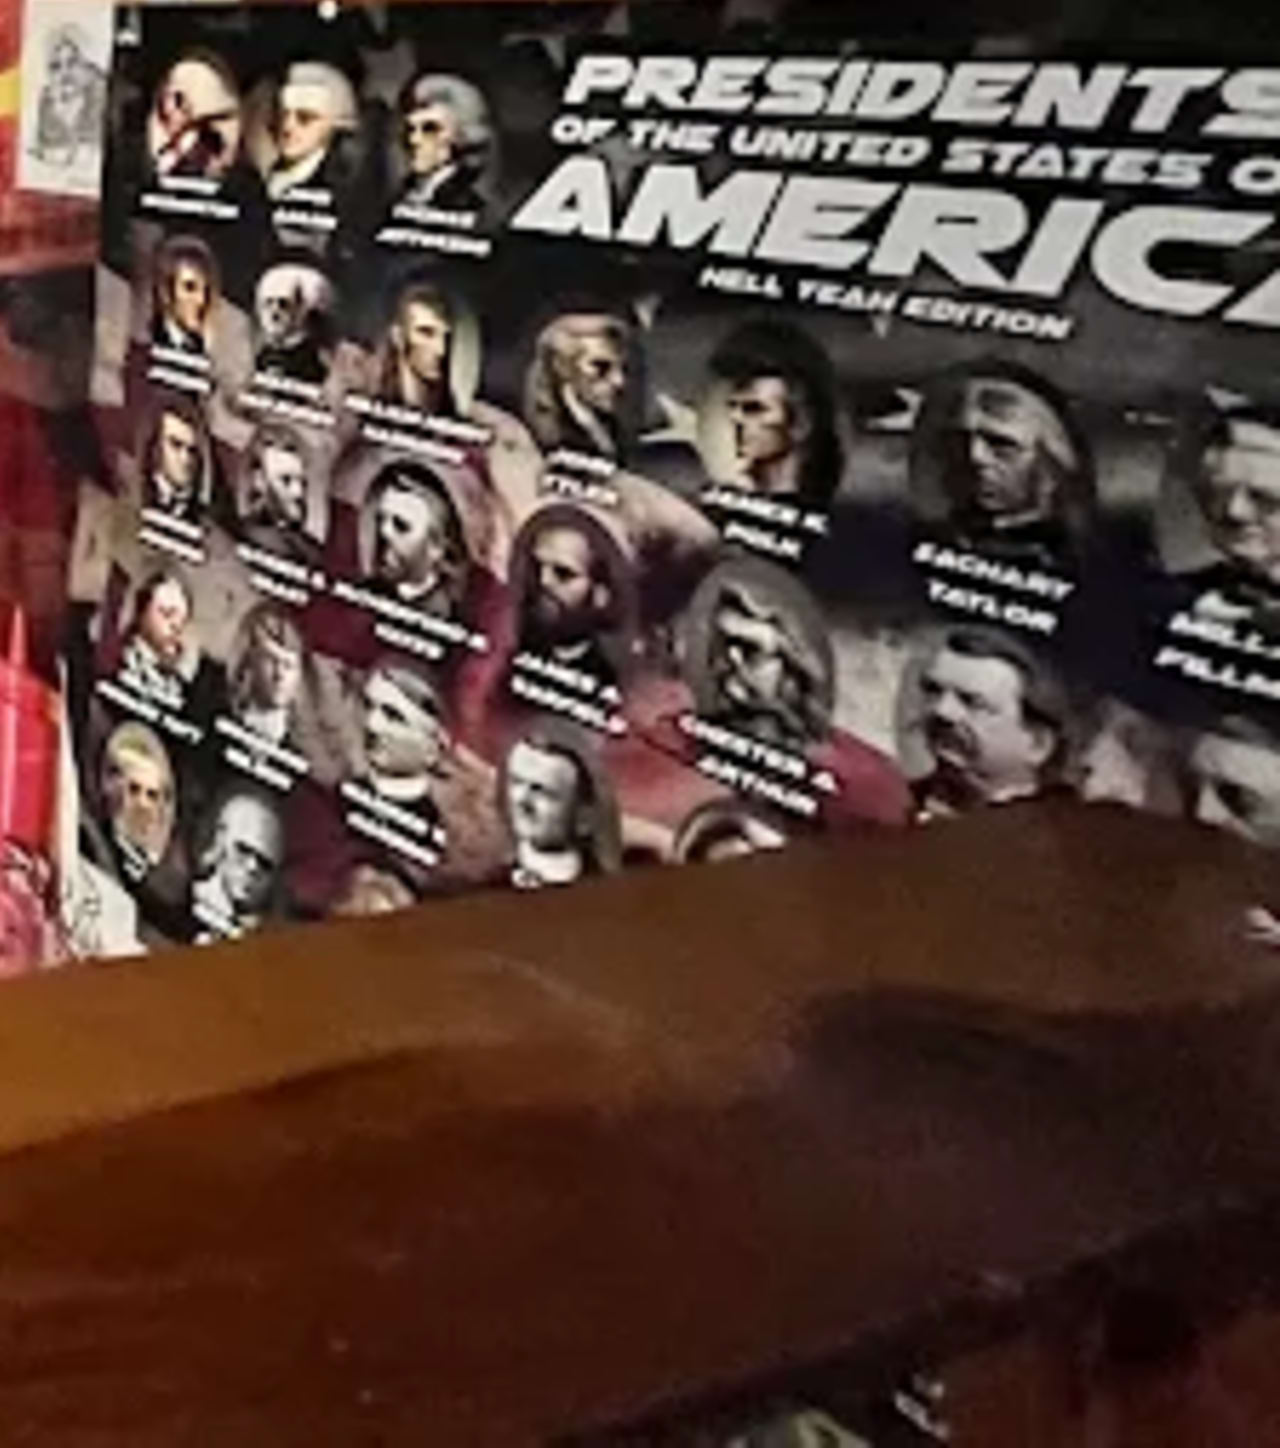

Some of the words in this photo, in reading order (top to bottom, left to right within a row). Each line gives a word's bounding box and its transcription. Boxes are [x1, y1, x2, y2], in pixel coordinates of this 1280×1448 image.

[563, 54, 1280, 139] PRESIDENTS
[553, 115, 618, 145] OF
[629, 118, 716, 153] THE
[730, 125, 935, 169] UNITED
[947, 138, 1214, 190] STATES
[903, 290, 1074, 341] EDITION
[926, 578, 1059, 636] TAYLOR
